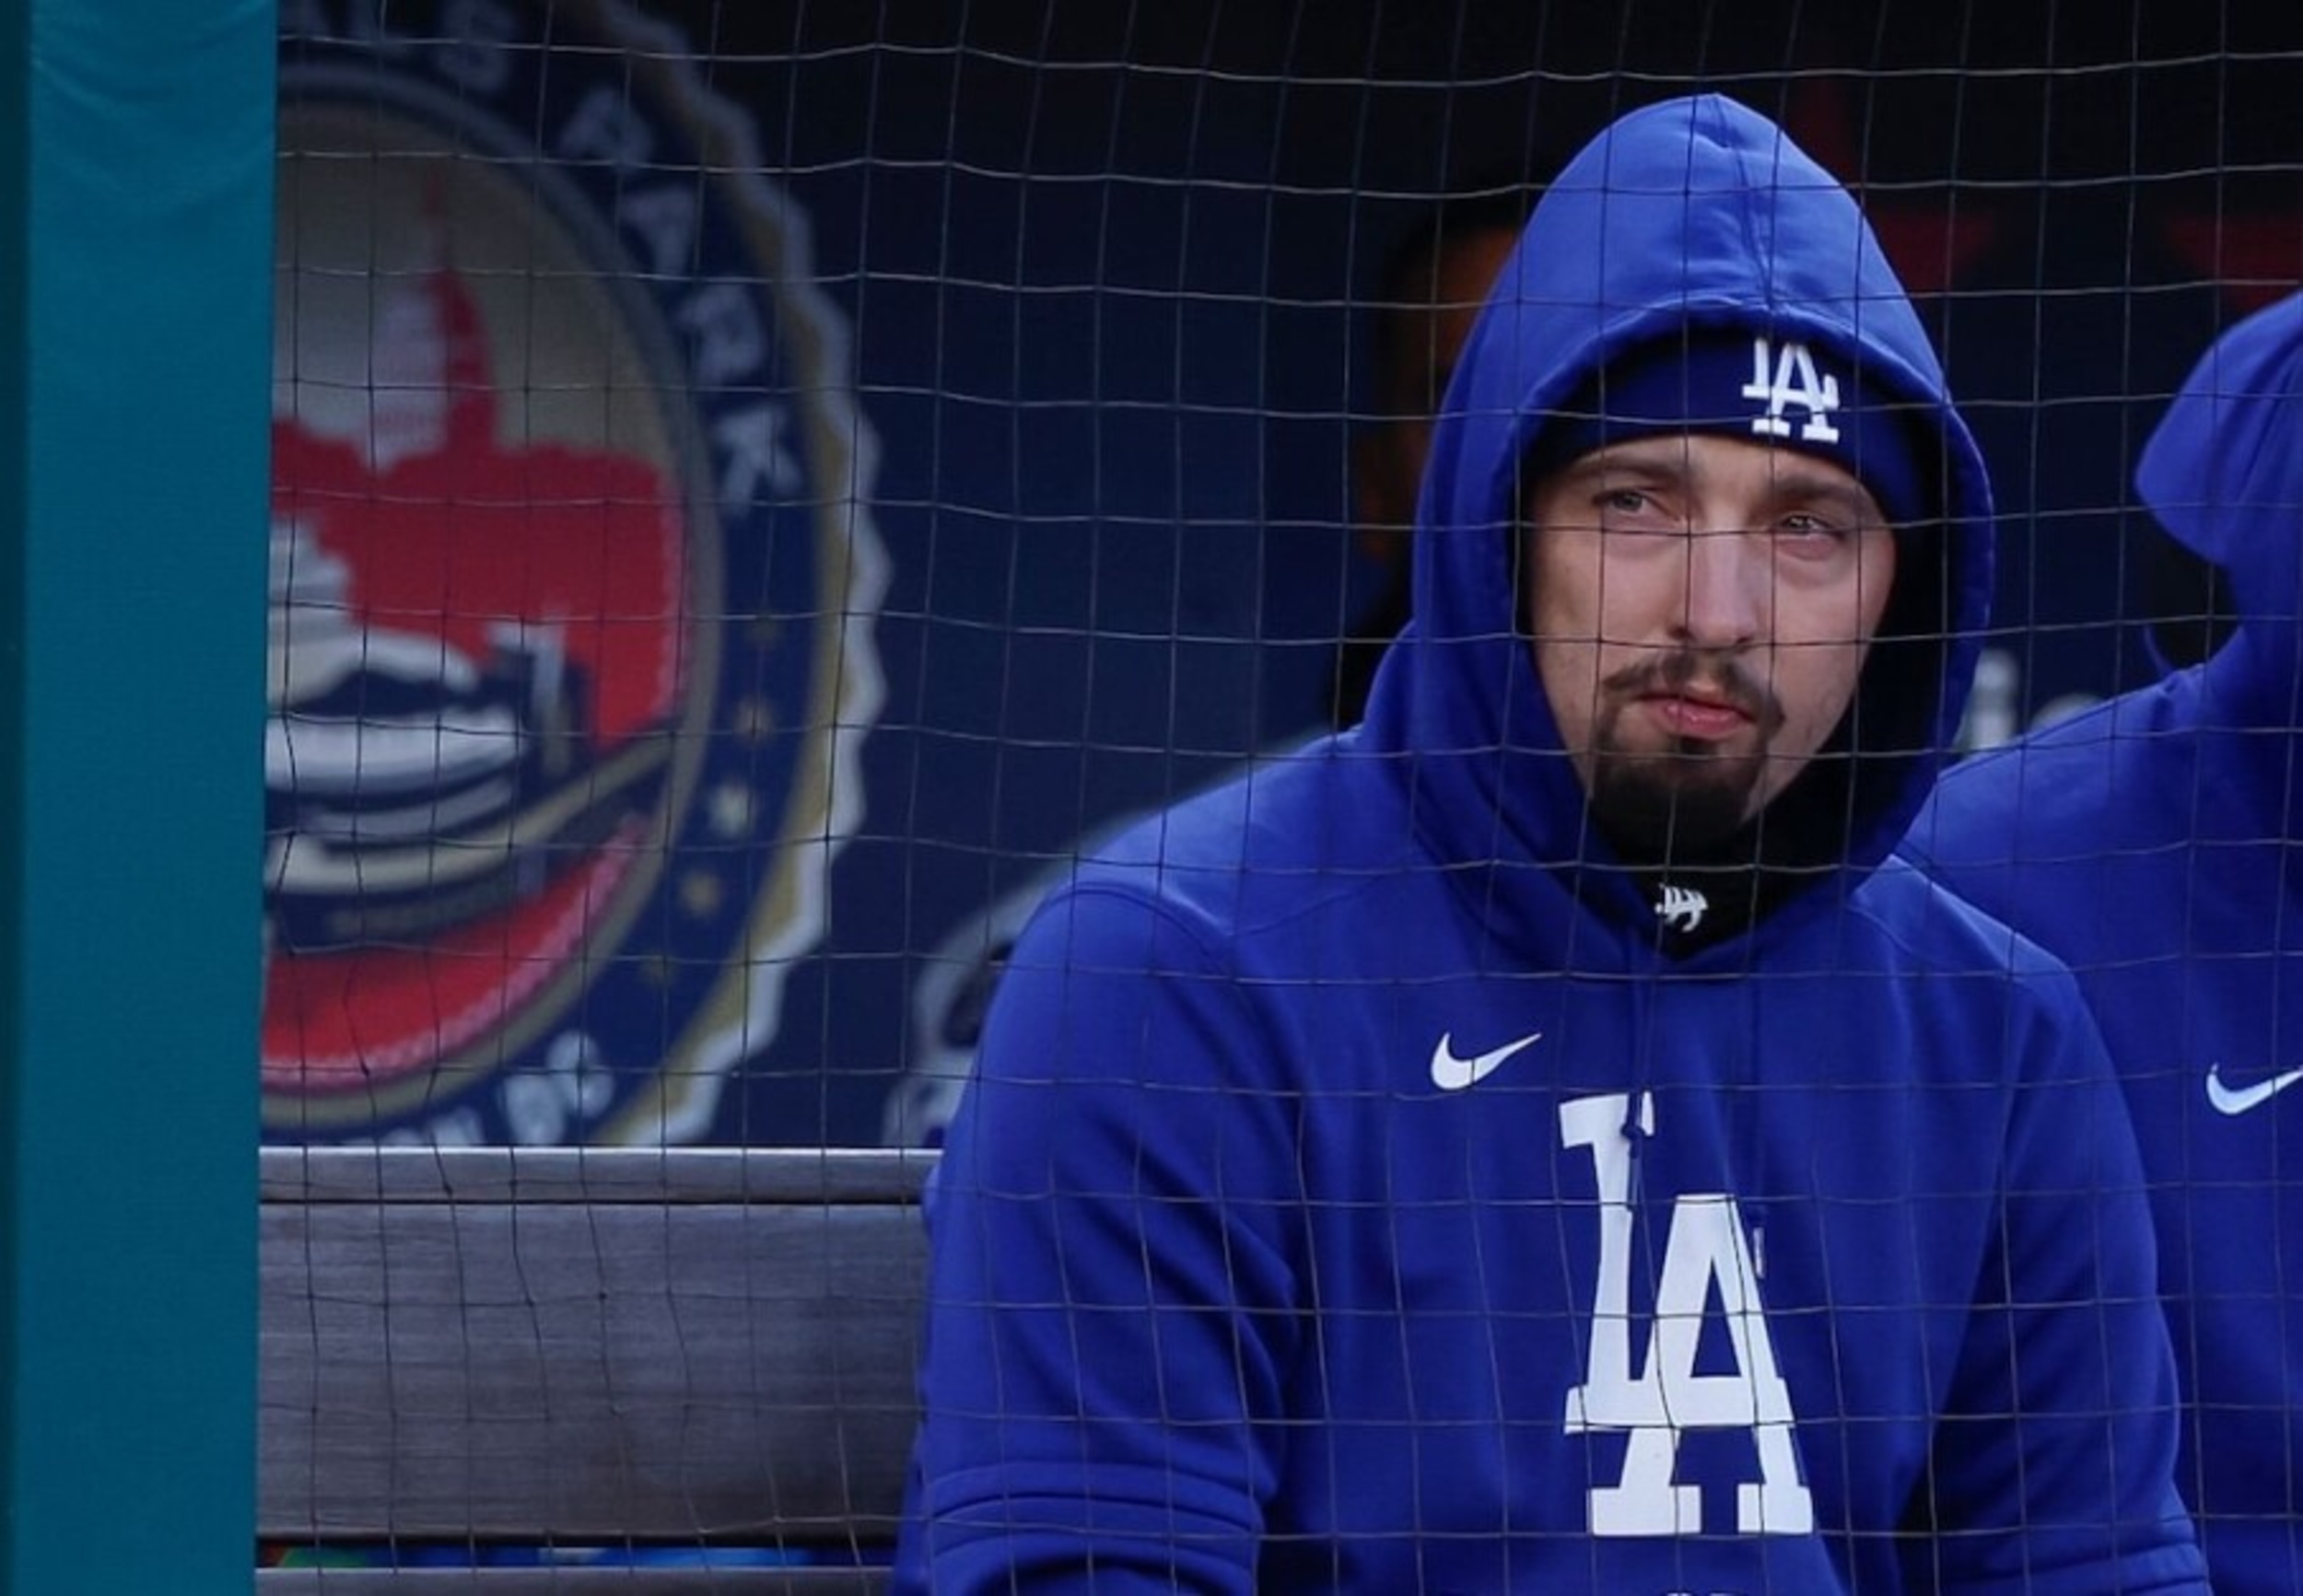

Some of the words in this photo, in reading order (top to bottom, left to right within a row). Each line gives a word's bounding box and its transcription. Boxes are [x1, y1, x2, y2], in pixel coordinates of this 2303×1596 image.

[556, 83, 803, 516] PARK
[1743, 338, 1840, 443] LA
[1559, 1091, 1814, 1536] LA
